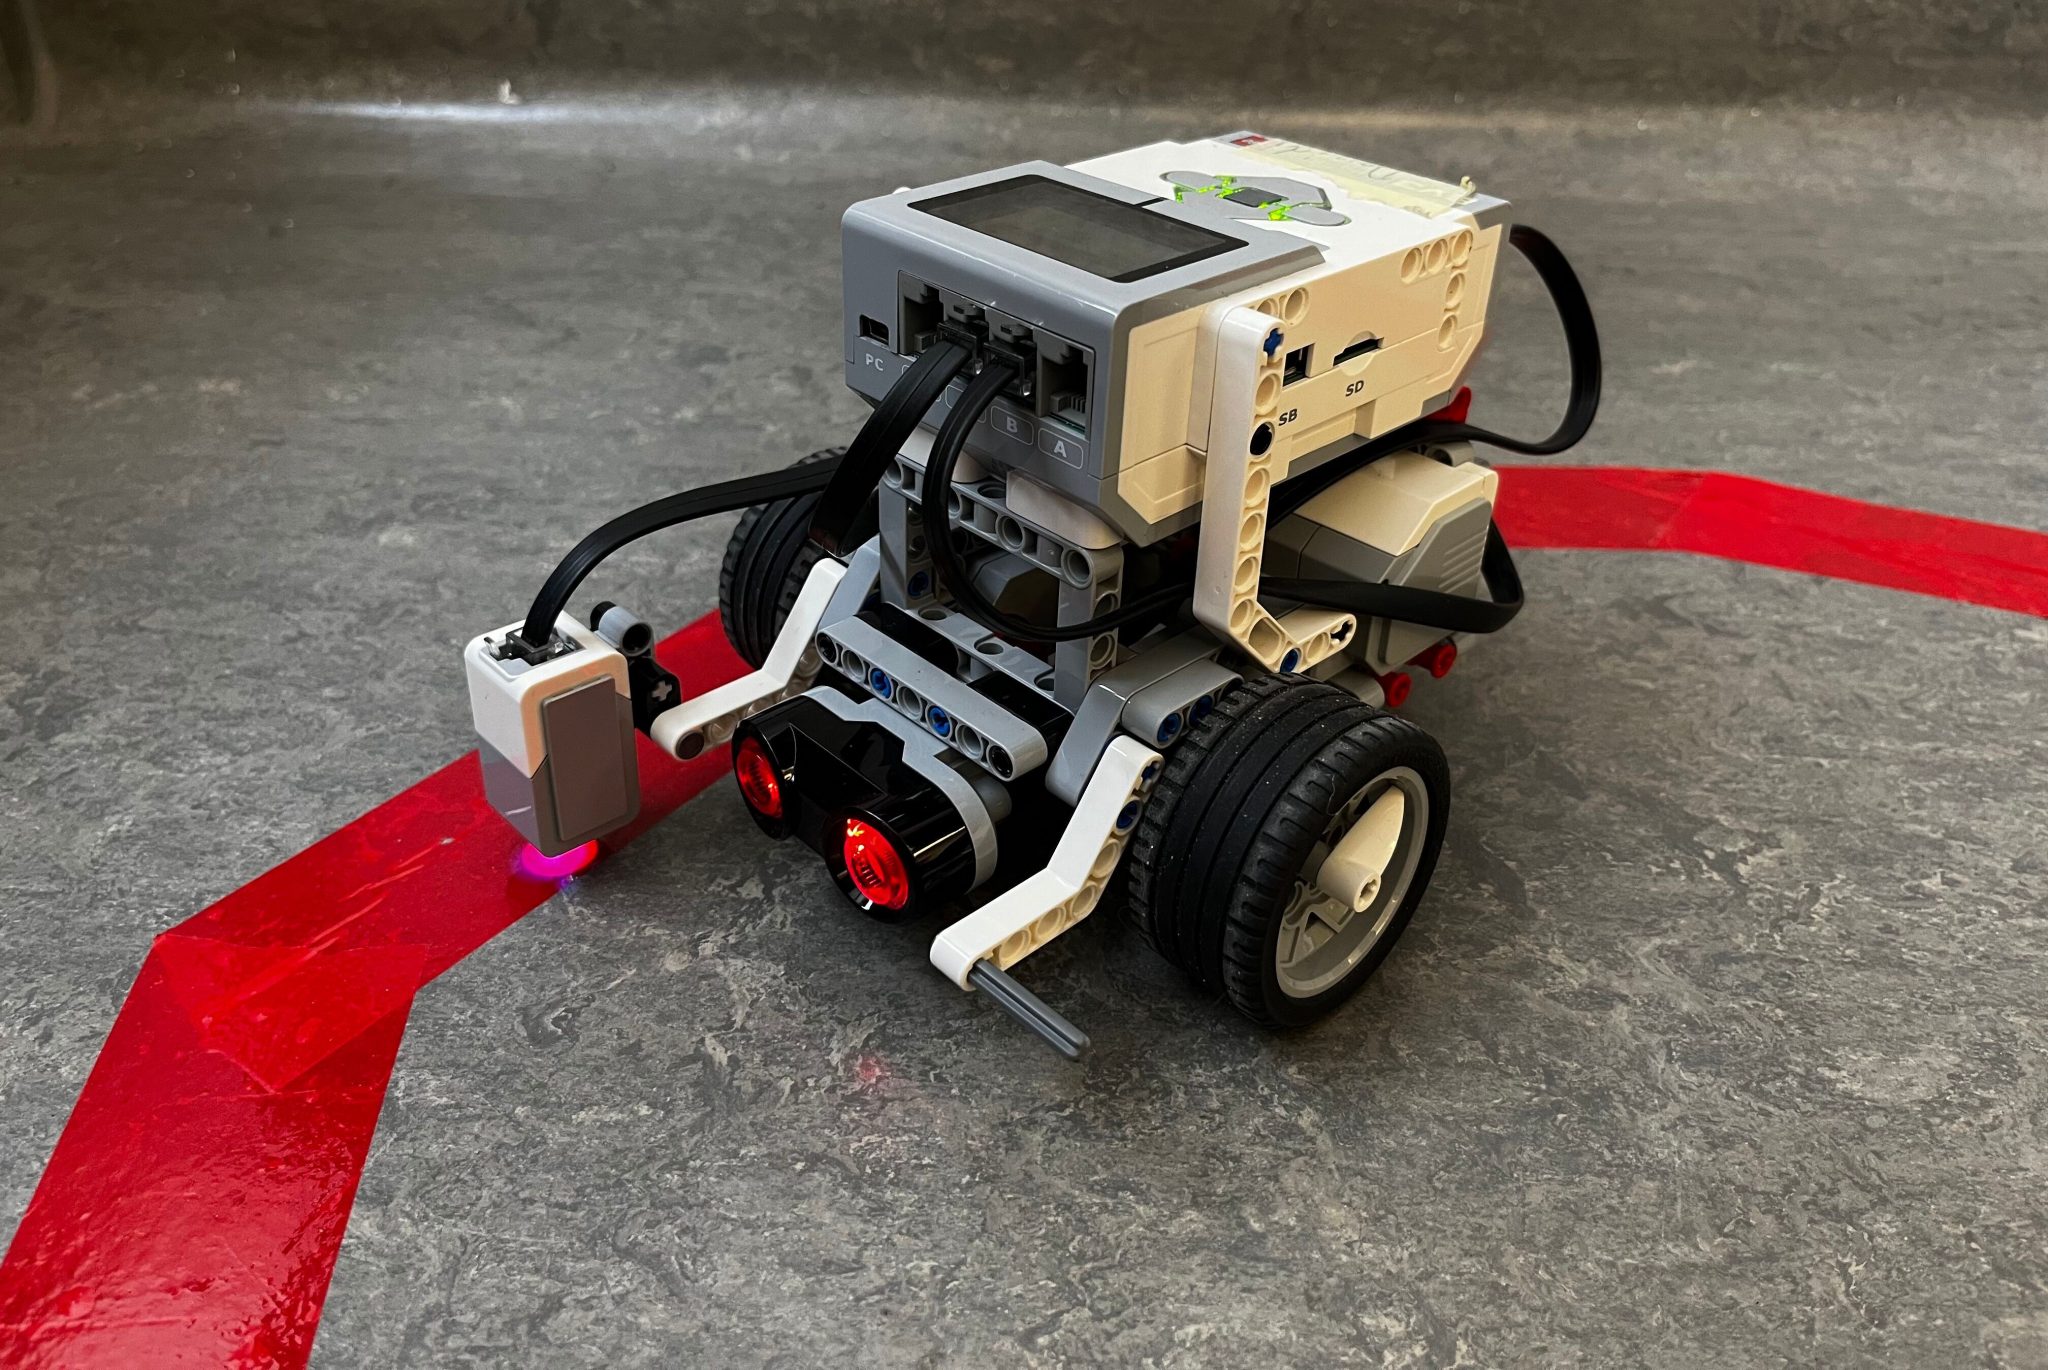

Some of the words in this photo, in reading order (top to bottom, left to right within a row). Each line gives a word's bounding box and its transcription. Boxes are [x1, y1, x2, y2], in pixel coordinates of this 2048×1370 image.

[866, 353, 884, 371] PC
[1345, 380, 1364, 397] SD
[1006, 417, 1018, 433] B
[1278, 408, 1298, 426] SB
[1053, 440, 1067, 458] A
